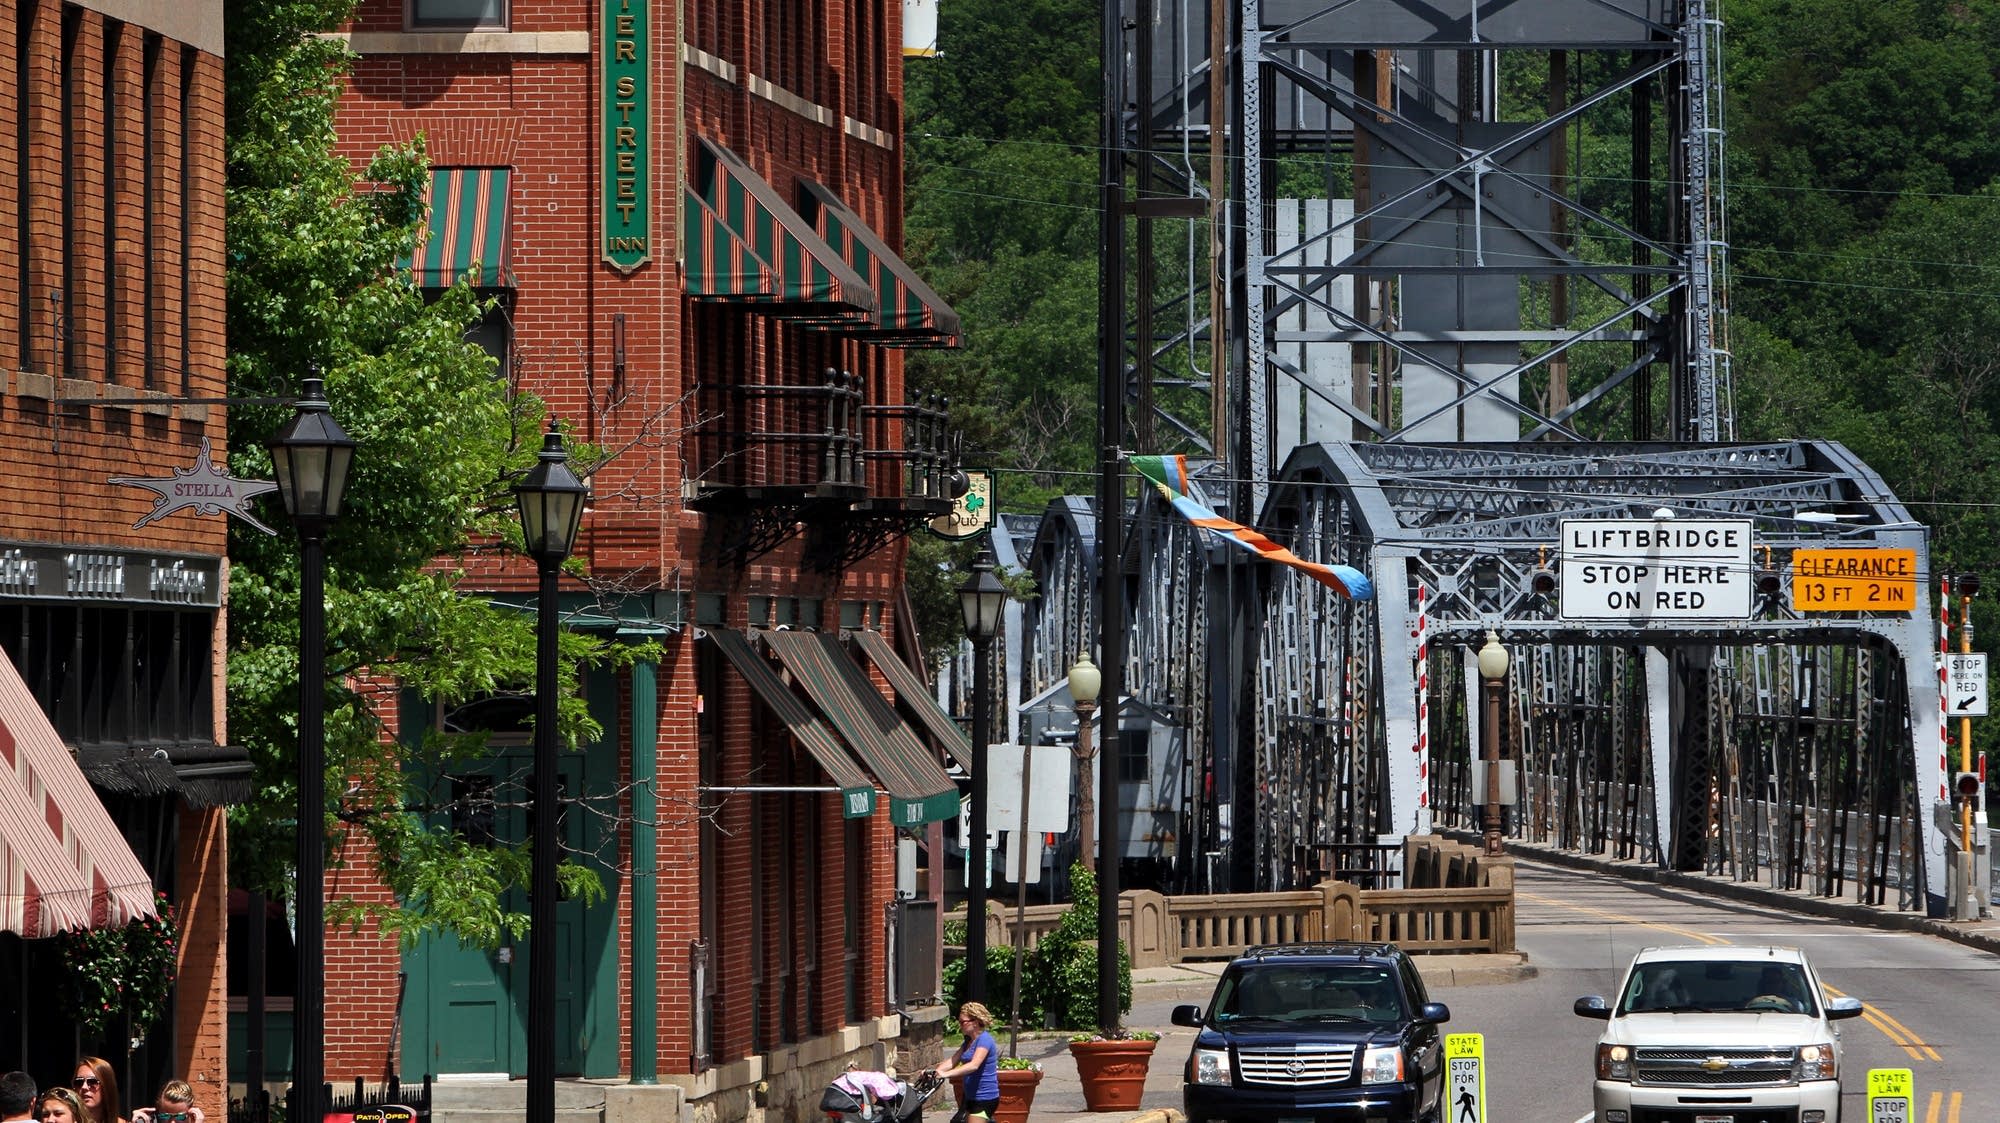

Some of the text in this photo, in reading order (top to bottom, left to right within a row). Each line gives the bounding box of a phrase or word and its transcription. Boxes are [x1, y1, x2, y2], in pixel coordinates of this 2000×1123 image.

[616, 76, 637, 224] STREET
[608, 236, 646, 252] INN
[175, 483, 234, 498] STELLA
[1573, 529, 1739, 548] LIFTBRIDGE
[1800, 557, 1908, 577] CLEARANCE
[1582, 566, 1730, 584] STOP HERE
[1607, 591, 1705, 609] ON RED
[1805, 584, 1904, 602] 13 FT 2 IN
[1952, 660, 1981, 670] STOP
[1957, 683, 1978, 692] RED
[1454, 1047, 1474, 1055] LAW
[1451, 1061, 1478, 1071] STOP
[1454, 1074, 1475, 1084] FOR
[1873, 1073, 1907, 1082] STATE
[1875, 1102, 1906, 1112] STOP
